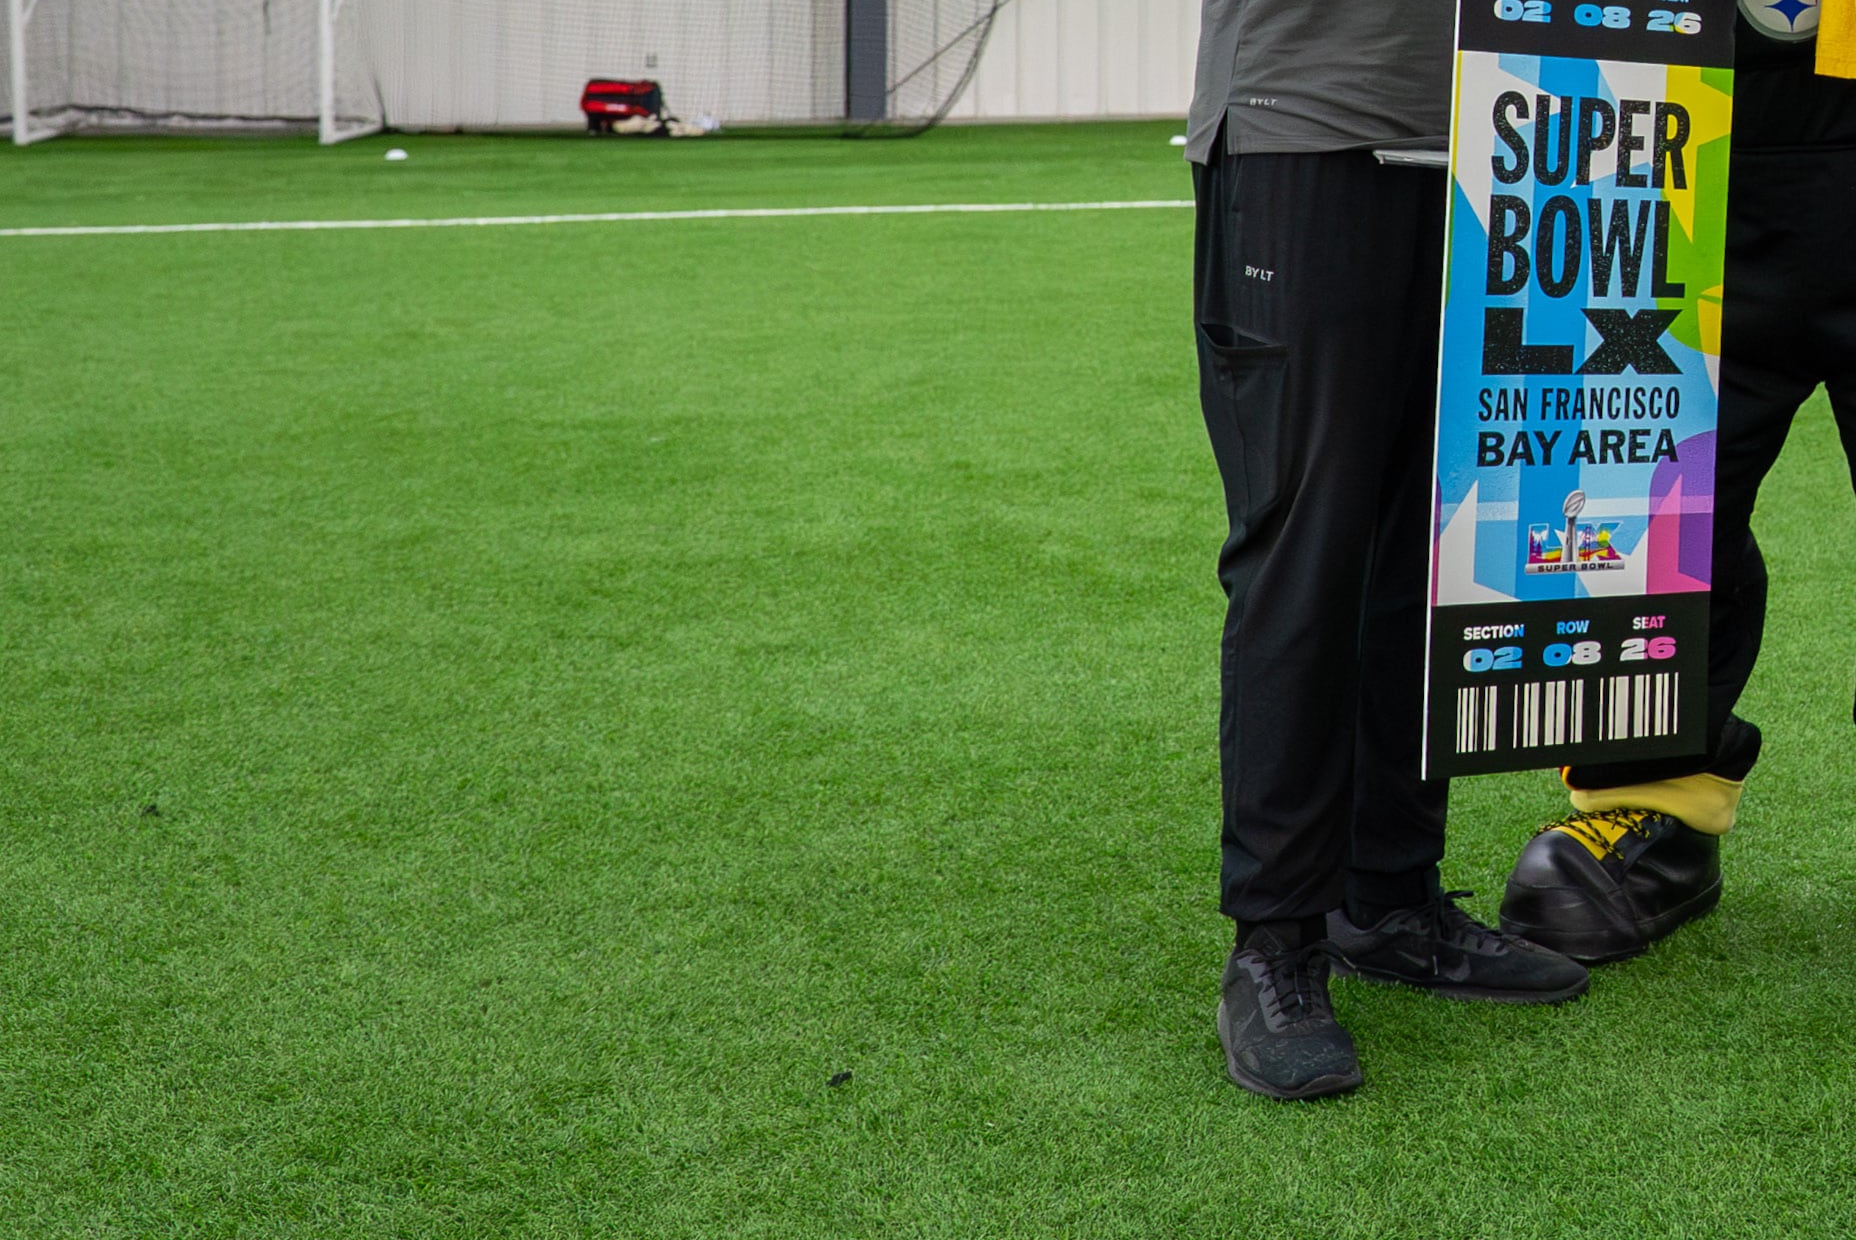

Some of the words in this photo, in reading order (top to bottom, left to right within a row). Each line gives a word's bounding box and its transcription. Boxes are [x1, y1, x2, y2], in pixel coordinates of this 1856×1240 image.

[1574, 4, 1631, 30] 08
[1646, 10, 1702, 35] 26
[1249, 97, 1278, 106] BYLT
[1491, 90, 1691, 190] SUPER
[1485, 194, 1686, 299] BOWL
[1244, 265, 1275, 282] BYLT
[1481, 307, 1684, 375] LX
[1478, 387, 1528, 422] SAN
[1540, 386, 1680, 421] FRANCISCO
[1476, 430, 1562, 467] BAY
[1568, 428, 1679, 465] AREA
[1537, 563, 1576, 573] SUPER
[1580, 562, 1614, 571] BOWL
[1463, 623, 1525, 641] SECTION
[1556, 620, 1590, 635] ROW
[1632, 615, 1666, 630] SEAT
[1463, 646, 1523, 672] 02
[1542, 641, 1602, 667] 08
[1619, 637, 1677, 661] 26
